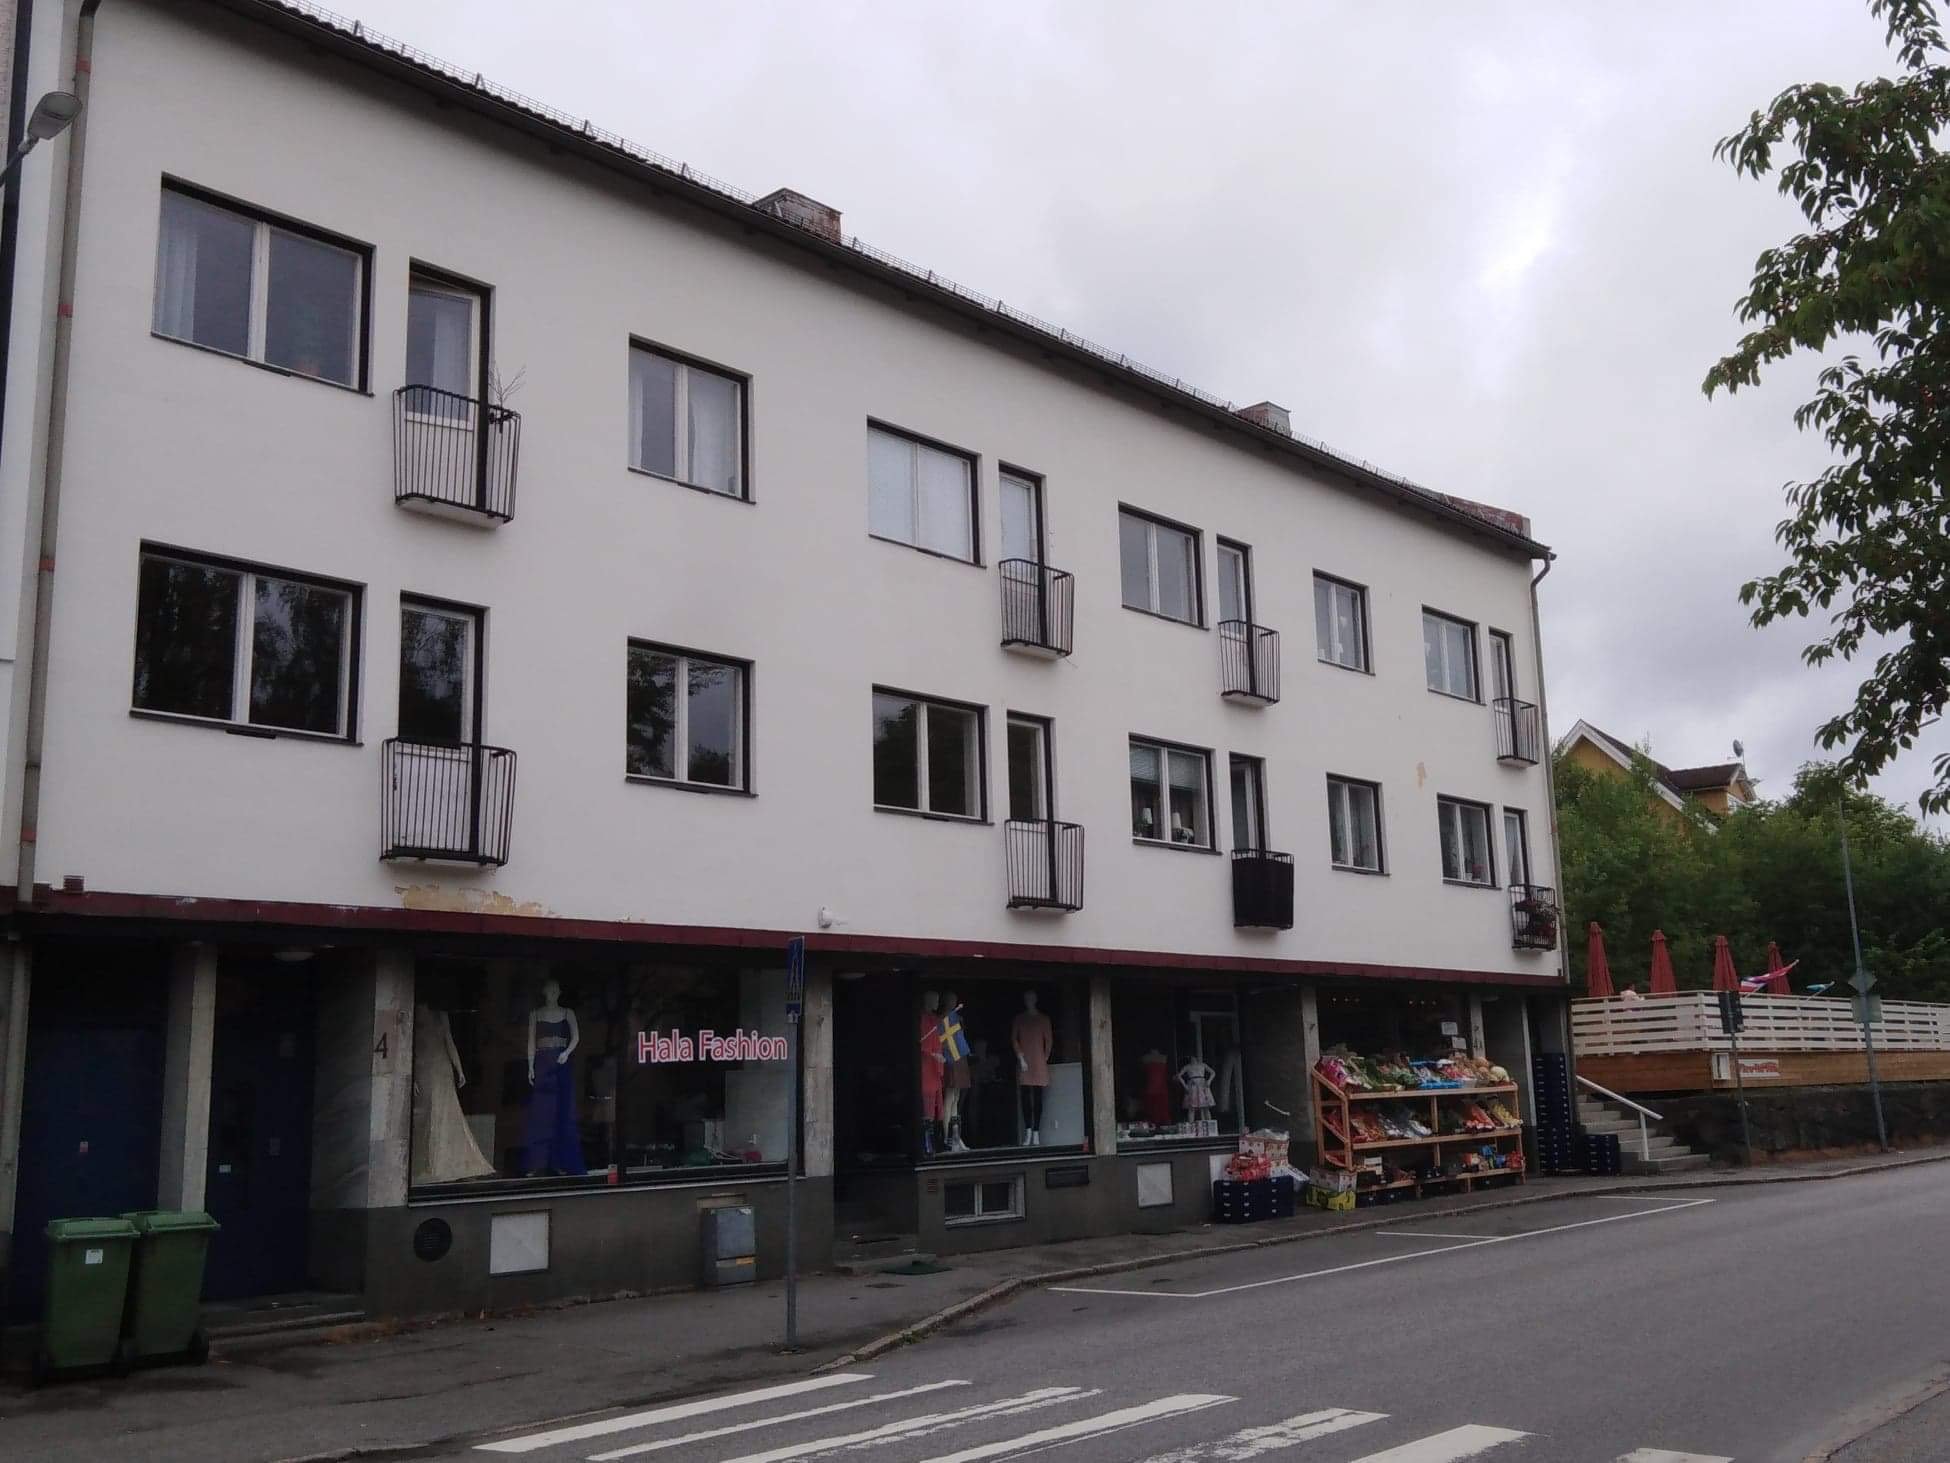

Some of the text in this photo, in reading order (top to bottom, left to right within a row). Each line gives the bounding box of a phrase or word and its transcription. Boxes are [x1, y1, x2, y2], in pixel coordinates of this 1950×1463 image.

[374, 1031, 389, 1060] 4
[638, 1029, 788, 1063] Hala Fashion
